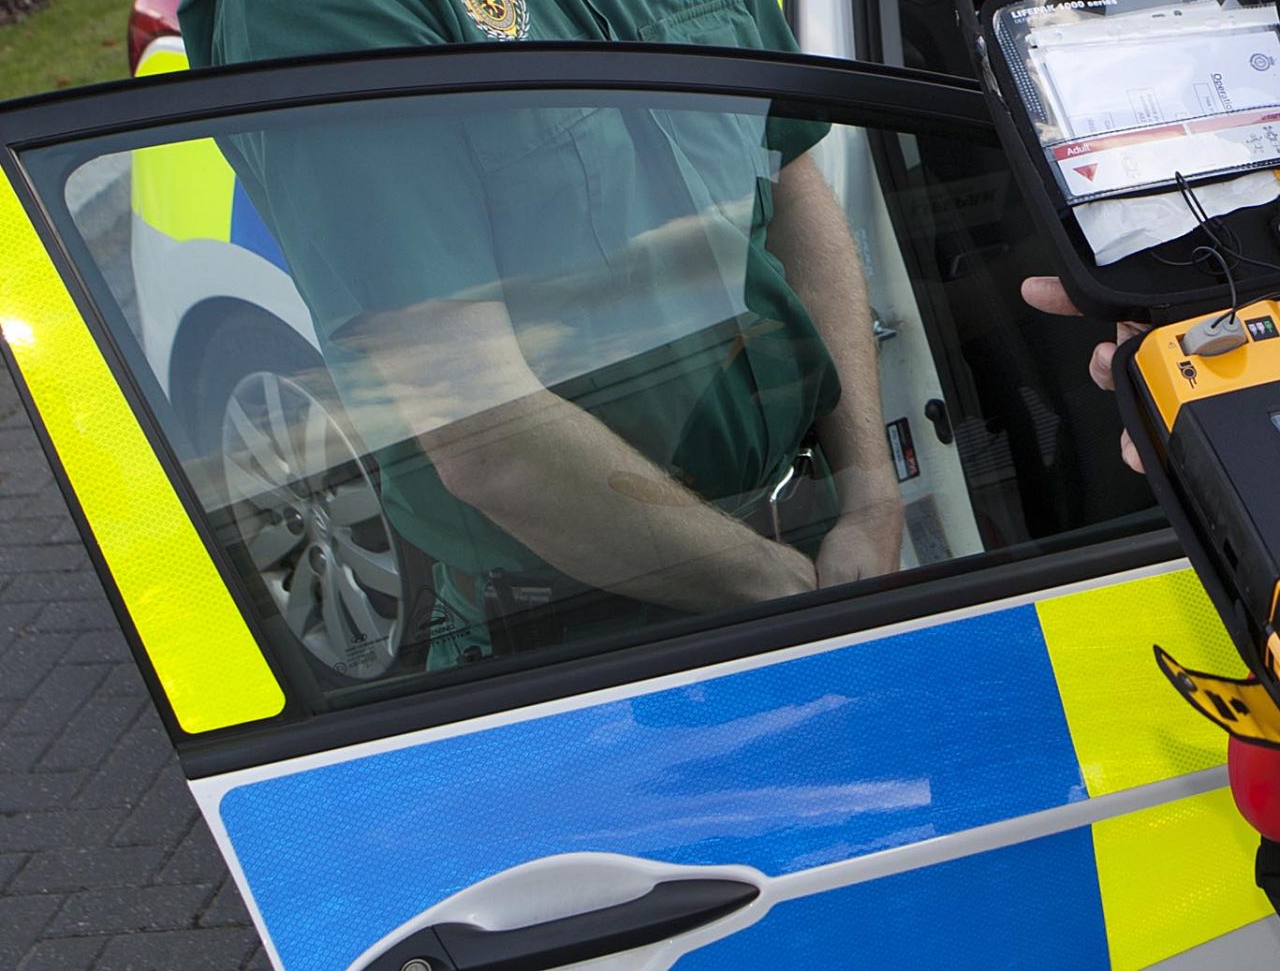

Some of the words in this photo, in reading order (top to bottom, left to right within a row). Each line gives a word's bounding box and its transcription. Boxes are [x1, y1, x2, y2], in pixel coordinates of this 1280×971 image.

[1010, 4, 1055, 19] LIFEPAK
[1057, 0, 1085, 11] 1000
[1066, 143, 1091, 156] Adult
